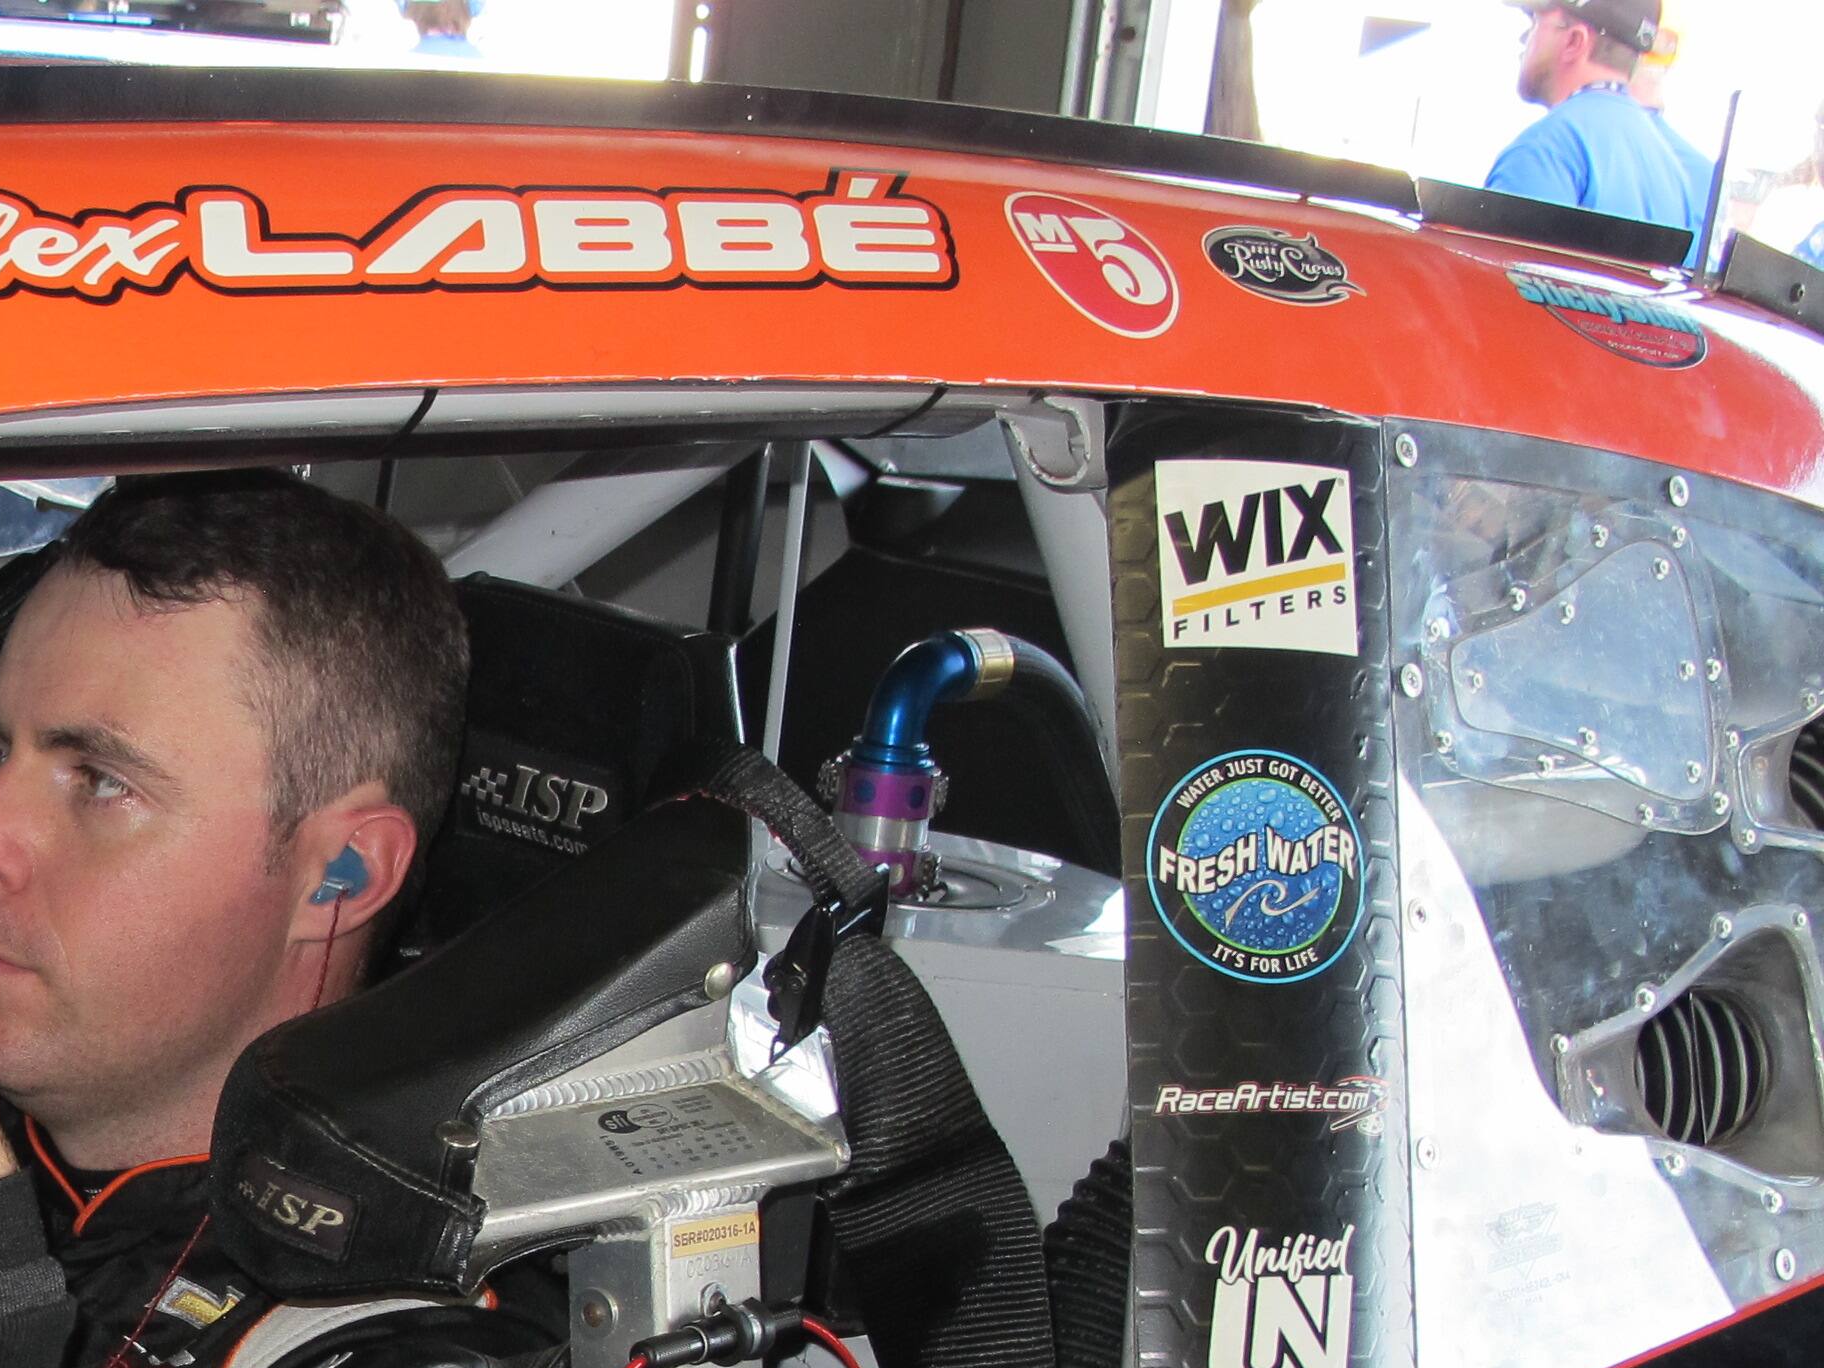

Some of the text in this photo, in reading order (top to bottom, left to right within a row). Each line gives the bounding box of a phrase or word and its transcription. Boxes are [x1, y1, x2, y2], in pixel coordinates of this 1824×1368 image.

[198, 174, 944, 277] LABBÉ
[1223, 242, 1285, 282] Rusty
[1163, 477, 1345, 586] WIX
[1173, 584, 1348, 640] FILTERS
[506, 763, 609, 831] ISP
[1176, 758, 1342, 823] WATER JUST GOT BETTER
[1159, 824, 1355, 894] FRESH WATER
[1212, 943, 1320, 974] IT'S FOR LIFE
[1154, 1080, 1371, 1115] RaceArtist.com
[257, 1181, 345, 1236] ISP
[1204, 1224, 1355, 1284] Unified
